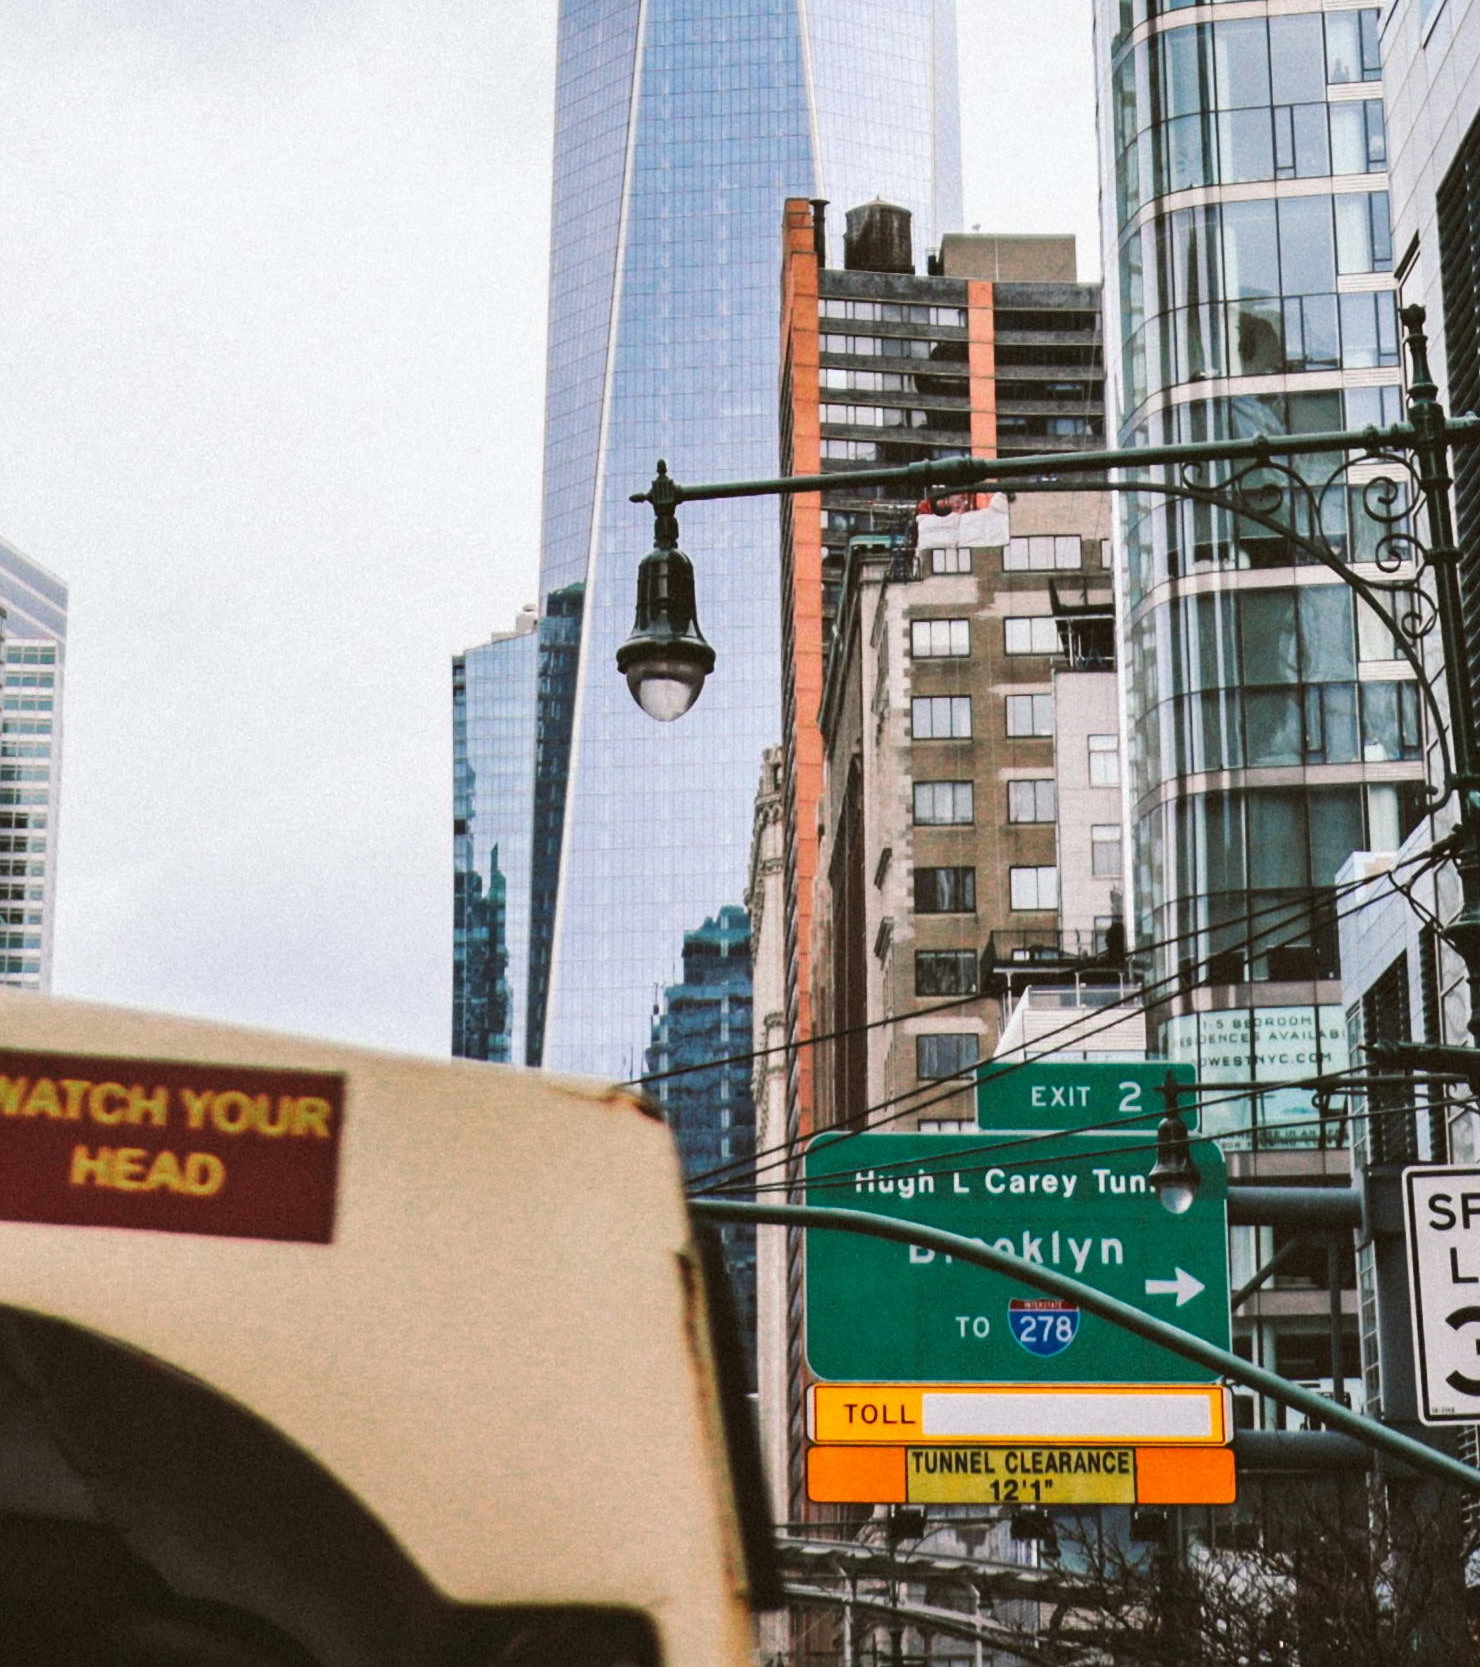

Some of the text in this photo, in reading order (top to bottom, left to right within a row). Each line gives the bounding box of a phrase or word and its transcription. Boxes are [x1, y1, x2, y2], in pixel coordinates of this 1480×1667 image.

[1232, 1016, 1312, 1030] BEDROOM
[1031, 1081, 1142, 1112] EXIT 2
[180, 1087, 332, 1138] YOUR
[69, 1144, 225, 1196] HEAD
[855, 1168, 1156, 1198] Hugh L Carey Tun
[955, 1315, 1072, 1342] TO 278
[844, 1404, 916, 1424] TOLL
[912, 1451, 1130, 1474] TUNNEL CLEARANCE
[989, 1479, 1053, 1502] 12'1"
